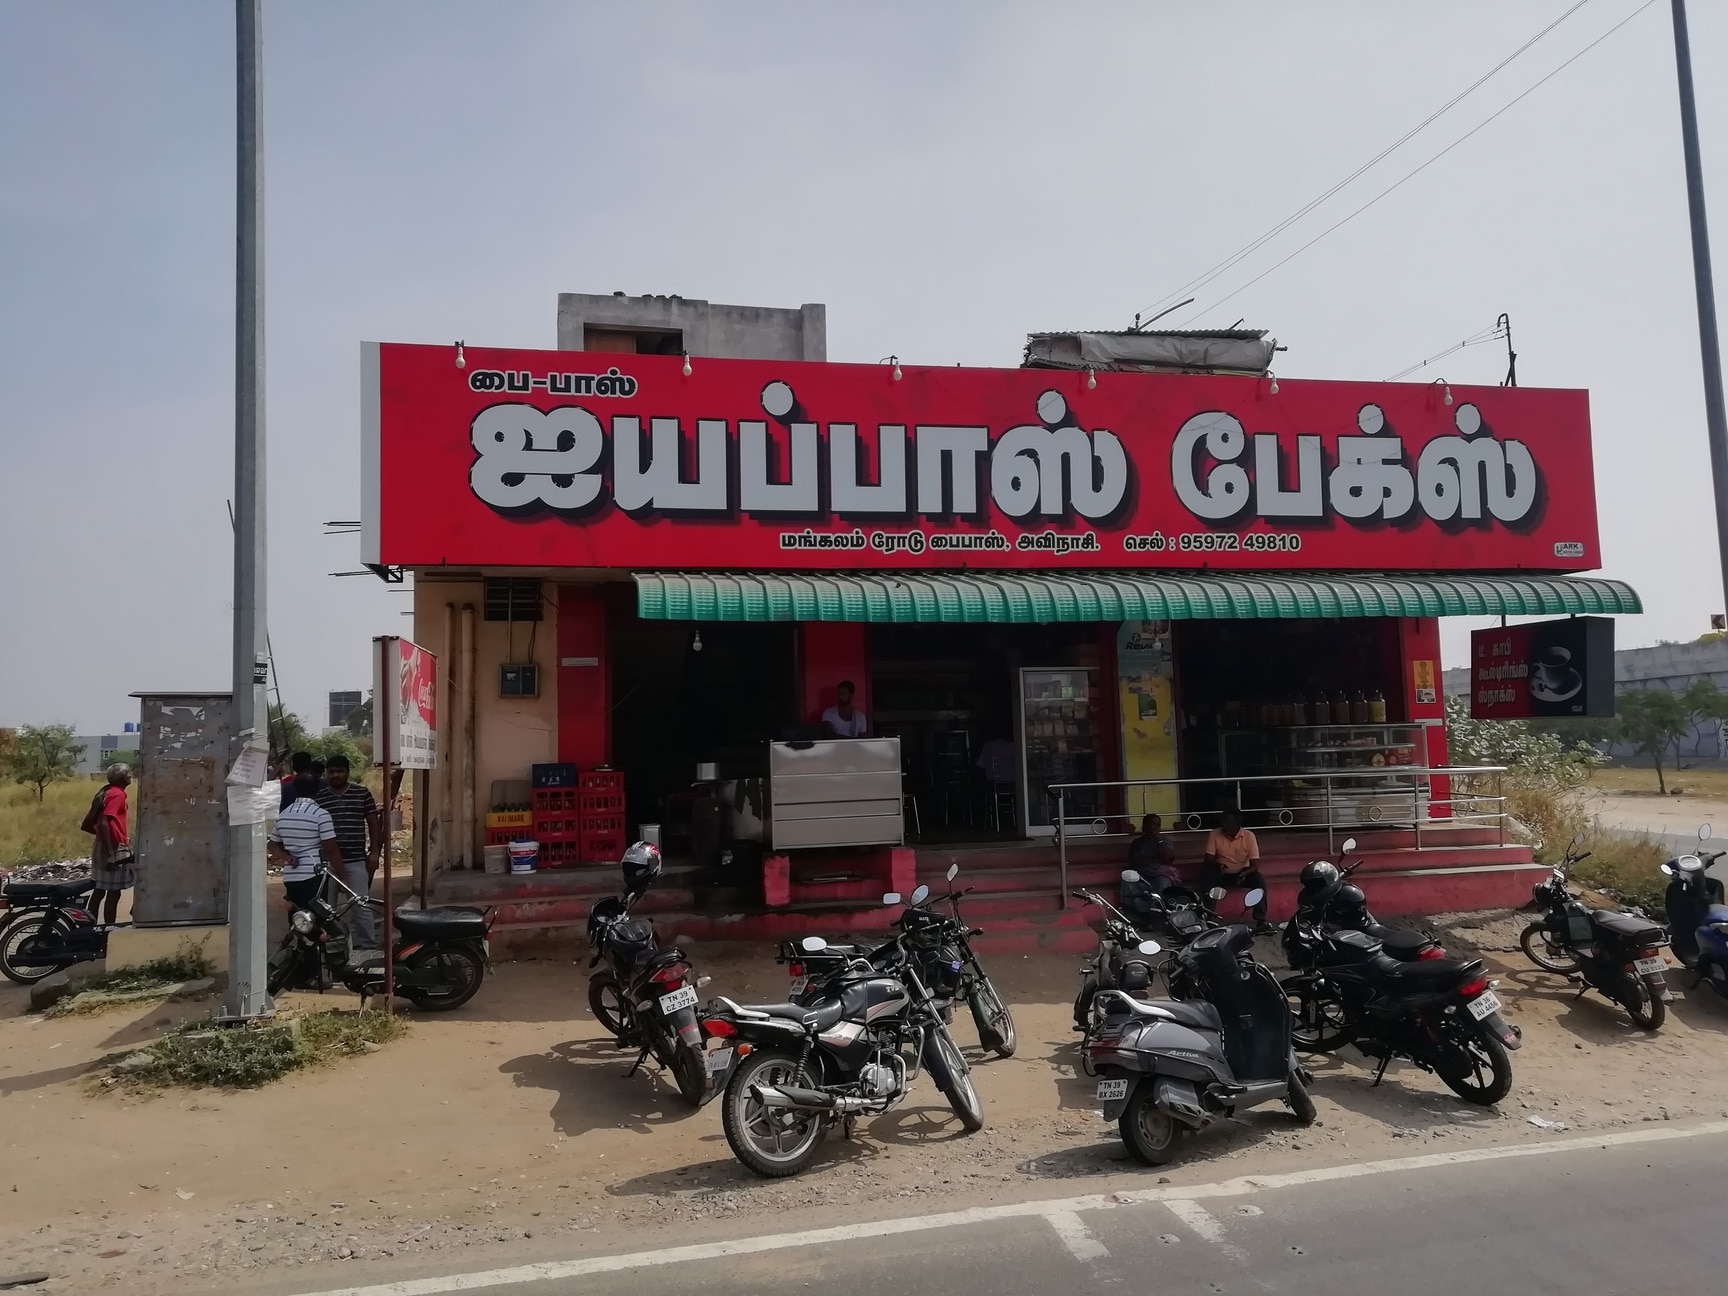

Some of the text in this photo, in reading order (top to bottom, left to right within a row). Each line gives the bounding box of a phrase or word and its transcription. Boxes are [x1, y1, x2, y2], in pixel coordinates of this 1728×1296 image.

[468, 367, 638, 398] பை-பாஸ்
[469, 380, 1538, 522] ஐயப்பாஸ் பேக்ஸ்
[780, 528, 866, 550] மங்கலம்
[870, 531, 925, 553] ரோடு
[1179, 532, 1240, 552] 95972
[1243, 532, 1301, 552] 49810
[667, 990, 689, 1003] TN 39
[666, 996, 695, 1012] CZ 3774
[1474, 1000, 1484, 1009] TN
[1476, 1008, 1486, 1018] AU
[1112, 1081, 1121, 1089] 39
